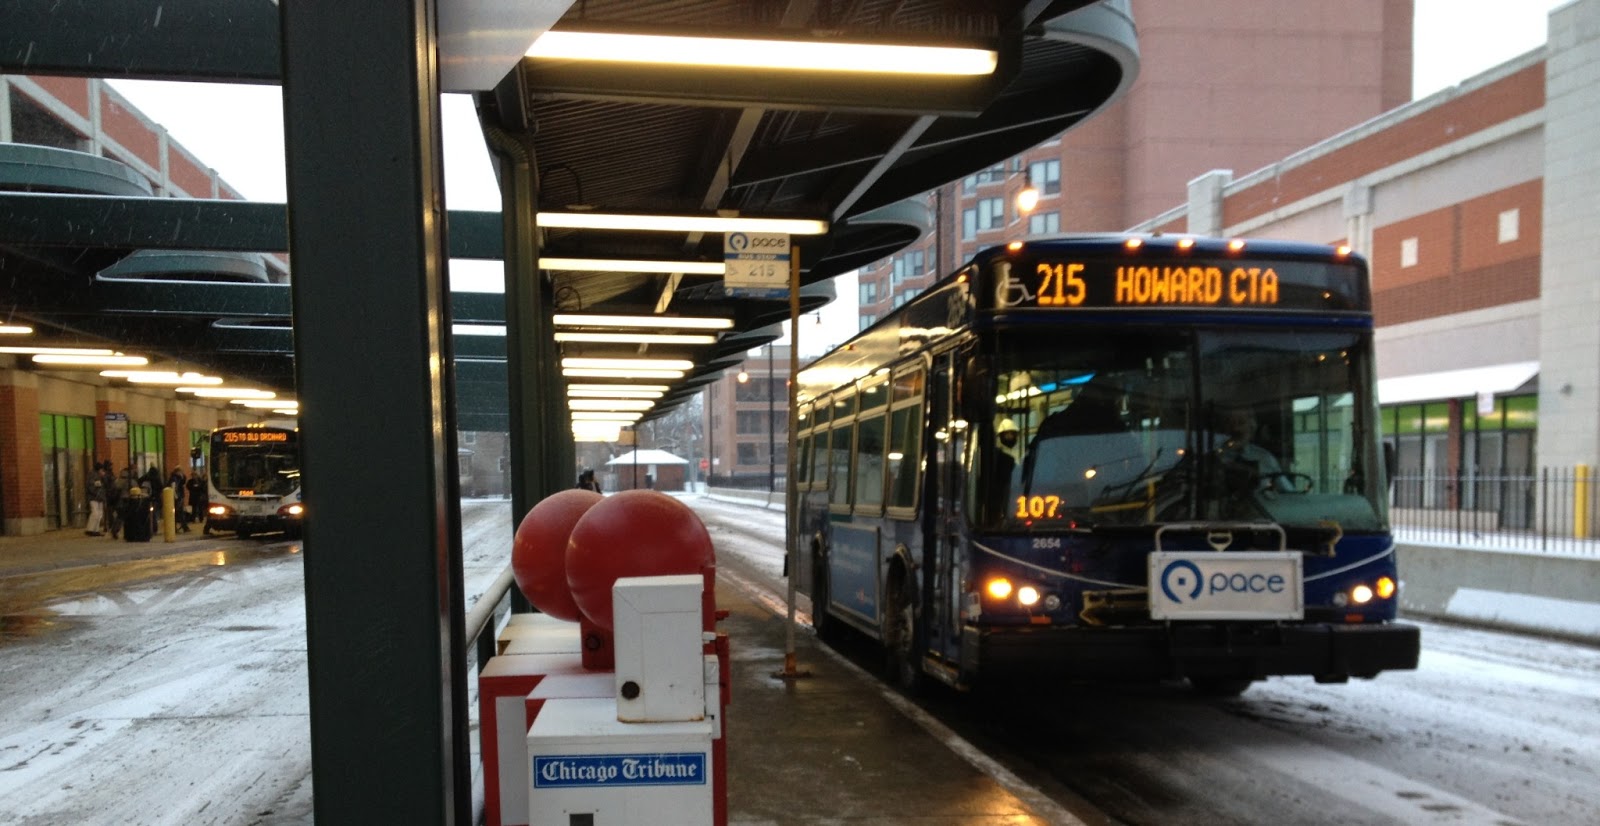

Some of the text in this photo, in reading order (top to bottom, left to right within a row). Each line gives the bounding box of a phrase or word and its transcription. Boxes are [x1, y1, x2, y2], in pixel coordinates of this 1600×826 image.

[1036, 263, 1279, 305] 215 HOWARD CTA
[1016, 495, 1060, 518] 107
[1032, 538, 1061, 549] 2654
[1209, 570, 1285, 596] pace
[541, 758, 697, 782] Chicago Tribune
